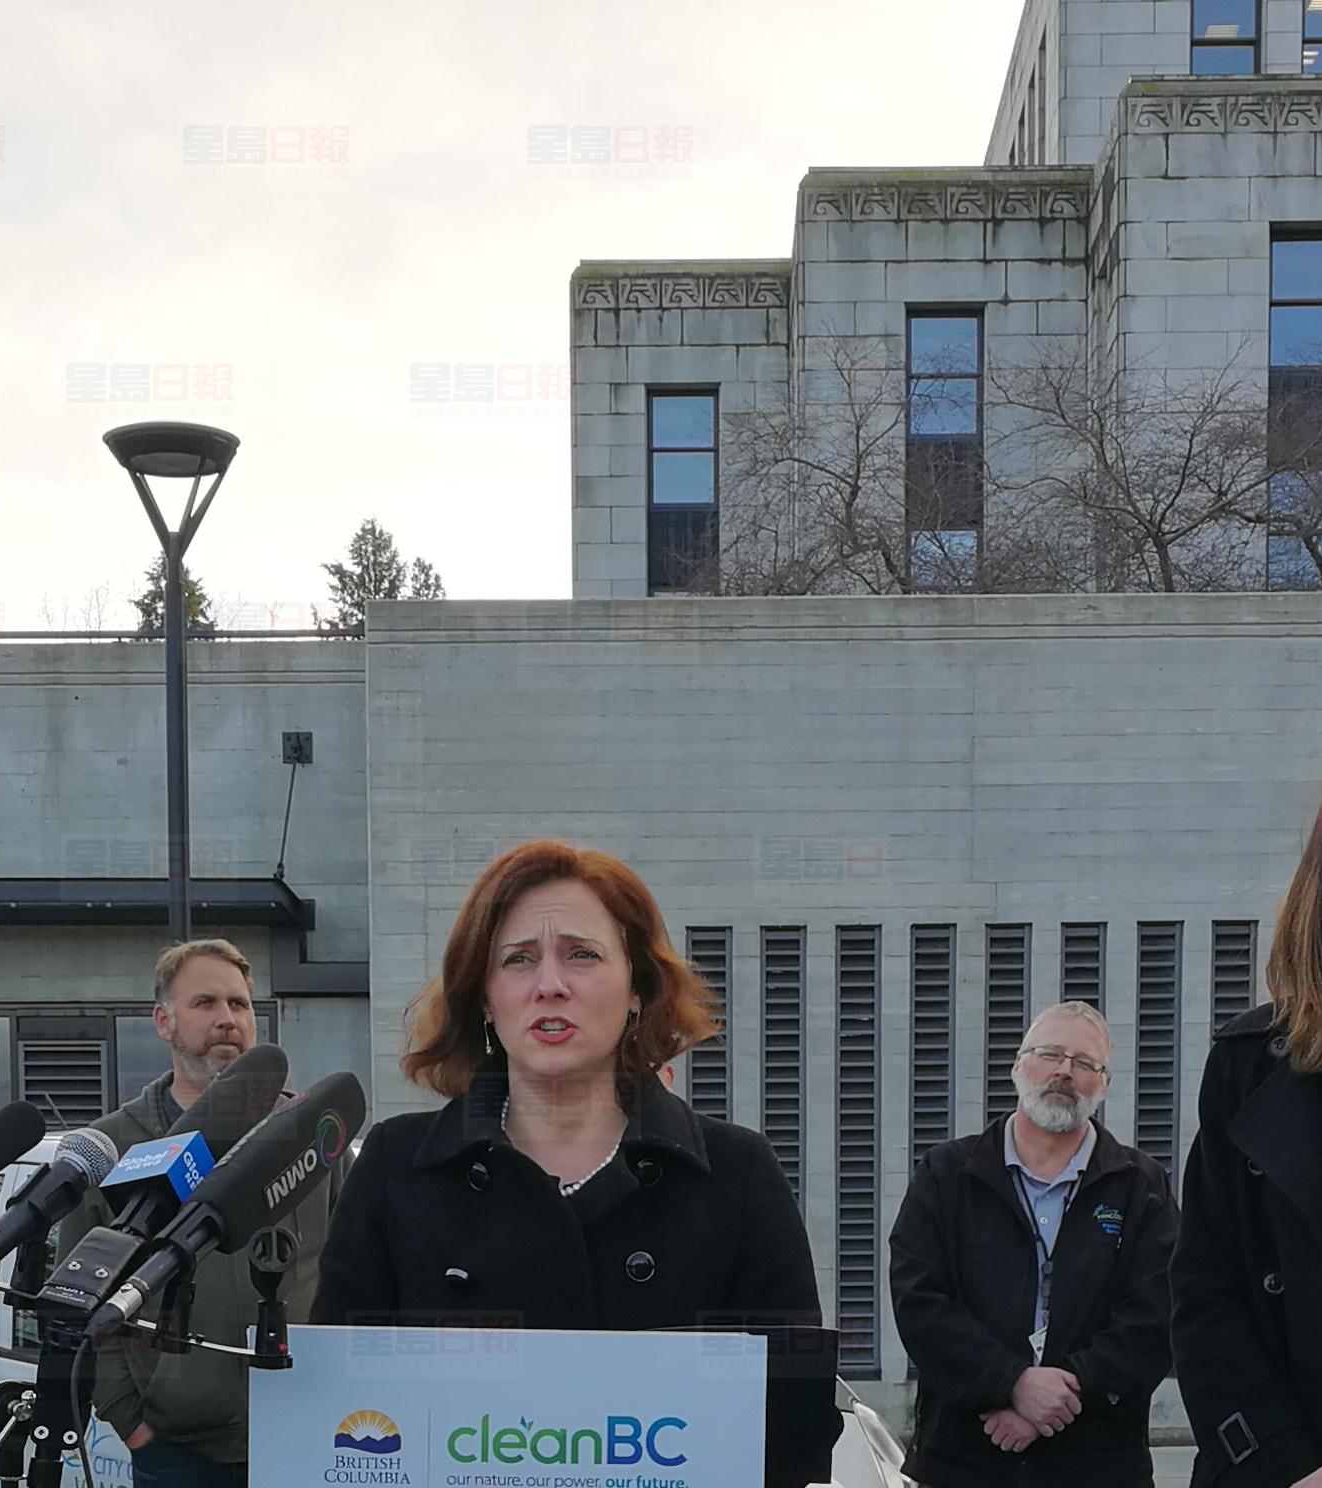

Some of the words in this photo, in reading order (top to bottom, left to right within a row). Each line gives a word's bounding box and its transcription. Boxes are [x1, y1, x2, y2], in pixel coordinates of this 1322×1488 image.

[447, 1414, 688, 1467] cleanBC
[93, 1456, 124, 1477] CITY
[333, 1455, 401, 1470] BRITISH
[324, 1468, 411, 1485] COLUMBIA
[447, 1476, 472, 1487] our
[475, 1475, 523, 1487] nature.
[526, 1476, 552, 1488] our
[605, 1477, 632, 1488] our
